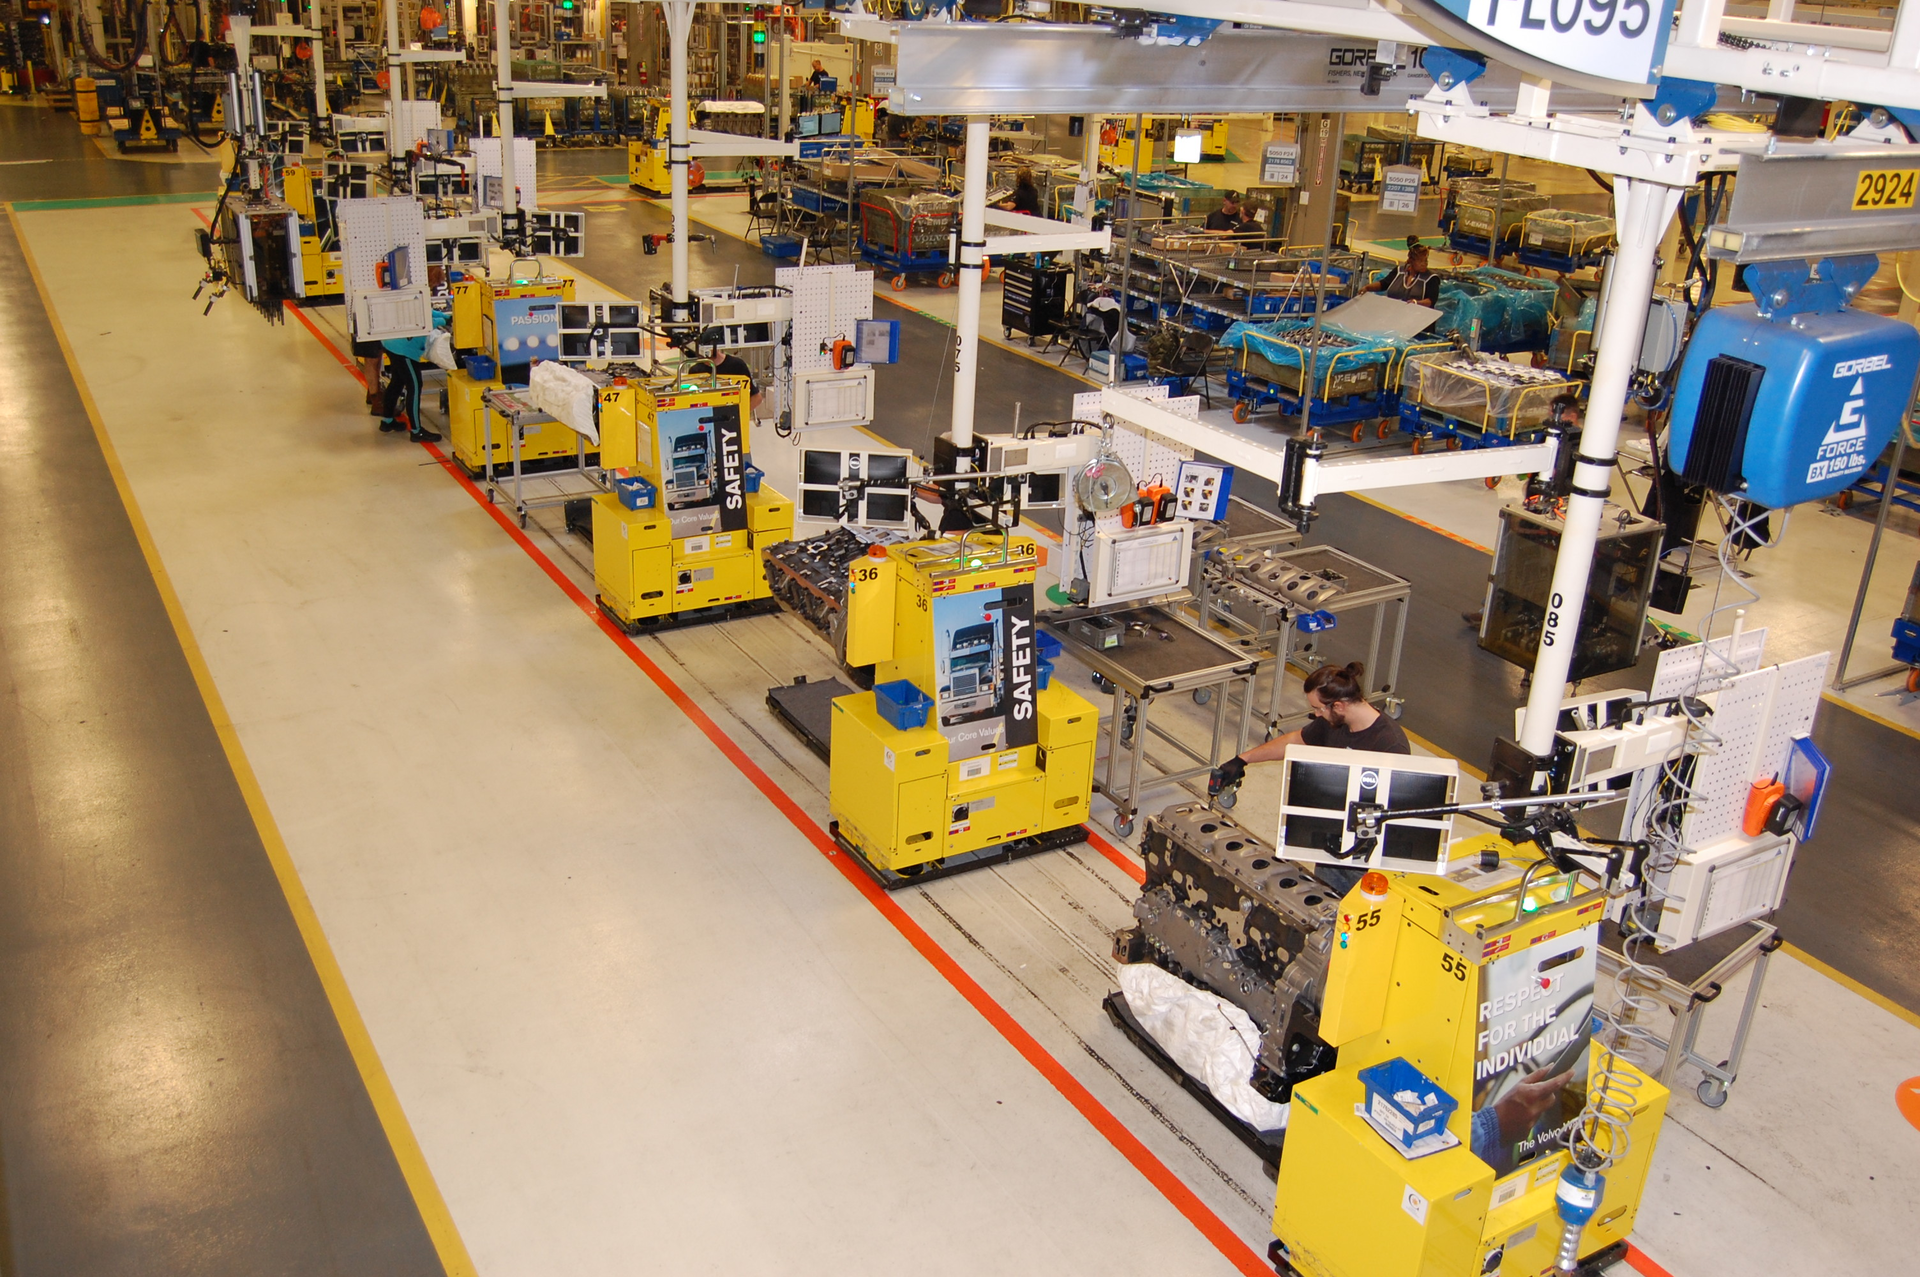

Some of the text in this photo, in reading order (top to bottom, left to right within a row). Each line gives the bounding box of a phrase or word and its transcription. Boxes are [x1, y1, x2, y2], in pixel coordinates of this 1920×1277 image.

[285, 169, 296, 177] 59
[1855, 172, 1915, 207] 2924
[454, 286, 469, 295] 77
[511, 313, 557, 326] PASSION
[1832, 354, 1892, 379] GORBEL
[603, 392, 620, 403] 47
[1816, 437, 1867, 460] FORCE
[720, 427, 743, 511] SAFETY
[1810, 453, 1866, 481] BX 150 lbs.
[681, 515, 698, 524] Core
[858, 566, 879, 582] 36
[916, 593, 929, 613] 36
[1543, 592, 1564, 647] 085
[1011, 615, 1034, 722] SAFETY
[945, 734, 957, 744] ur
[958, 730, 978, 743] Core
[1355, 908, 1382, 932] 55
[1440, 951, 1468, 982] 55
[1477, 1003, 1557, 1052] FOR THE
[1476, 1023, 1579, 1081] INDIVIDUAL
[1518, 1139, 1536, 1153] The
[1537, 1127, 1561, 1145] Volvo
